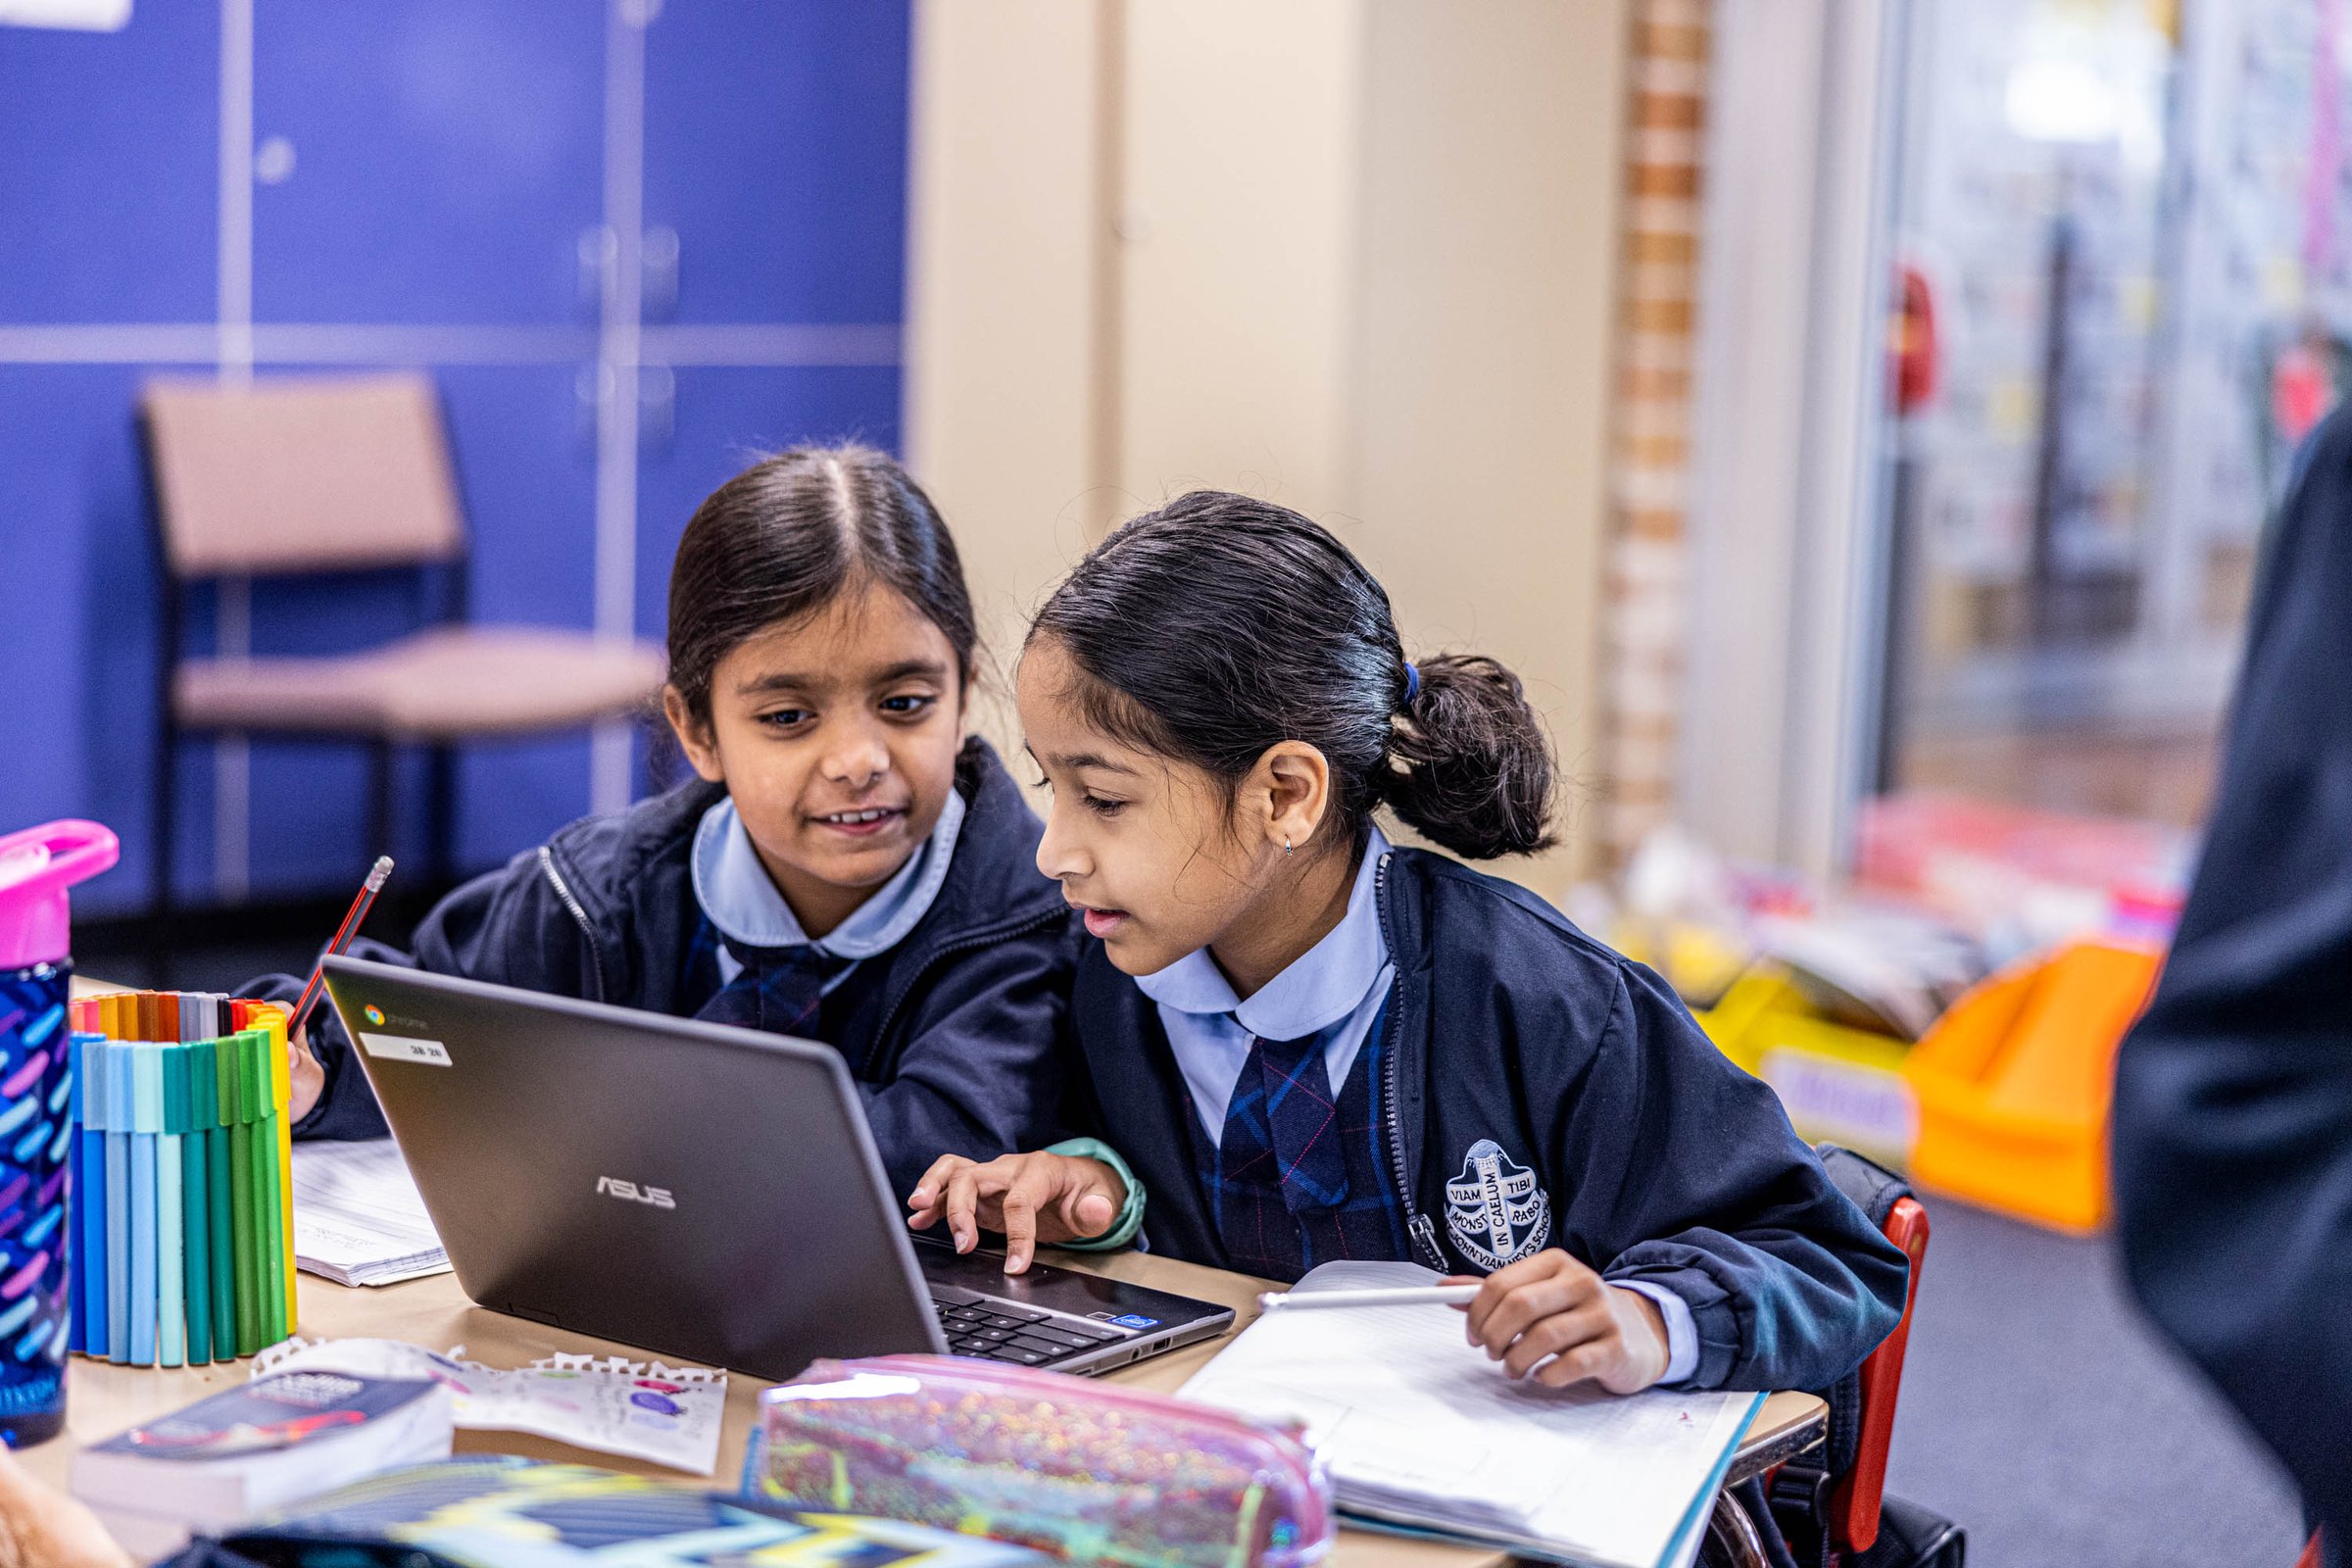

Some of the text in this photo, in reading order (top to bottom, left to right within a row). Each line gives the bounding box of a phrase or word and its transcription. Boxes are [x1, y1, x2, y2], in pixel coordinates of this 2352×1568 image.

[597, 1176, 676, 1209] ASUS
[1450, 1179, 1530, 1201] VIAM TIBI
[1450, 1200, 1540, 1231] MONST RABO
[1484, 1172, 1508, 1246] IN CAELUM
